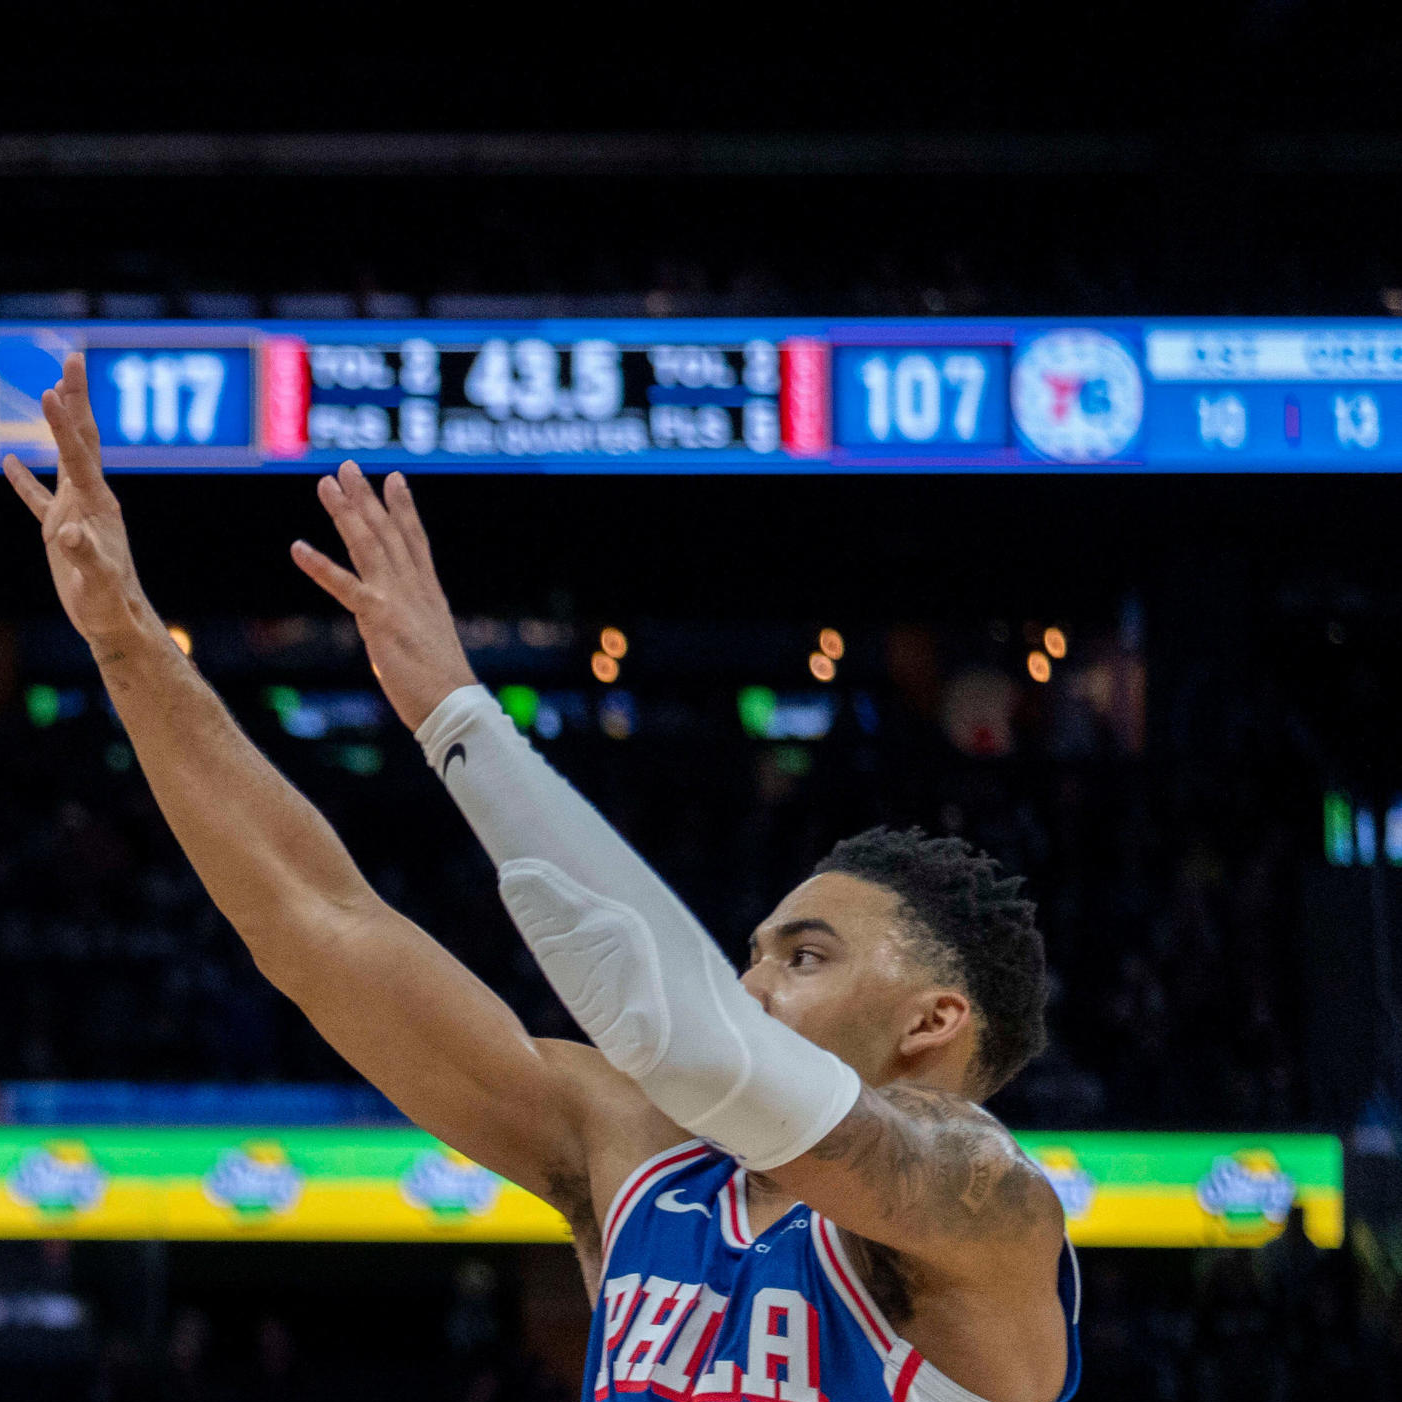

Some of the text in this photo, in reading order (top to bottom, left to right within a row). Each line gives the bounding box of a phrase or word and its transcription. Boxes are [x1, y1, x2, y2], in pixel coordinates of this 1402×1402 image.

[112, 354, 225, 442] 117
[466, 338, 623, 421] 43.5
[863, 355, 985, 442] 107
